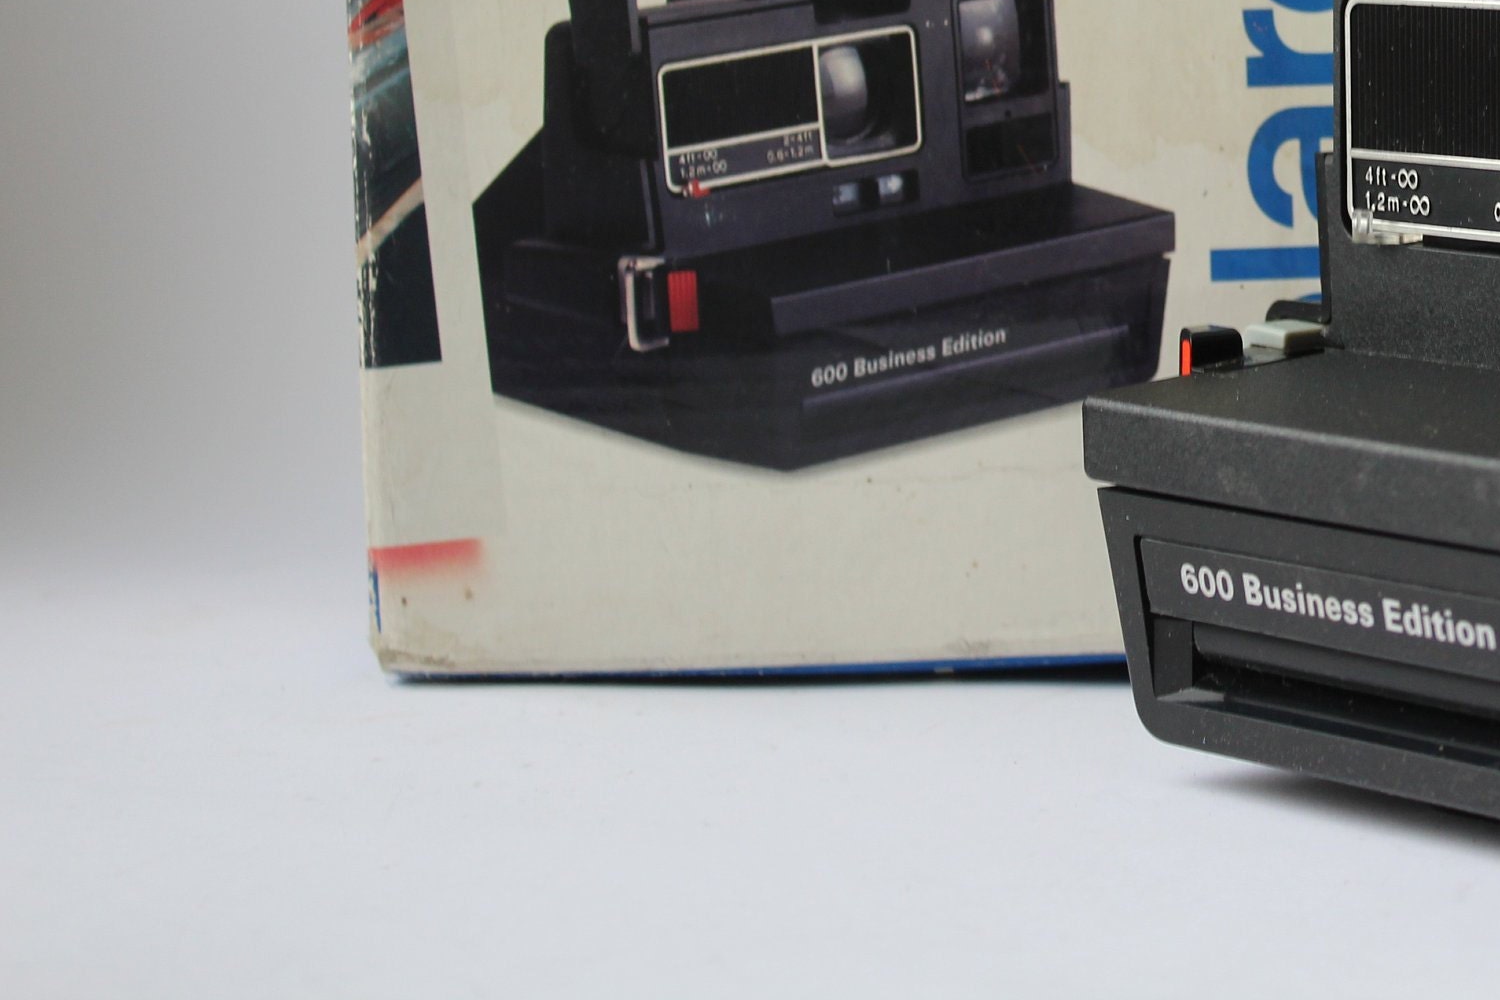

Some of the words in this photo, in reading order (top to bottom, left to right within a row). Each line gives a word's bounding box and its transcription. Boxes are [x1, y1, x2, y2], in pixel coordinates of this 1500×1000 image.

[811, 361, 848, 388] 600
[854, 345, 936, 377] Business
[941, 327, 1007, 357] Edition
[1180, 562, 1234, 601] 600
[1242, 573, 1375, 627] Business
[1381, 597, 1497, 650] Edition
